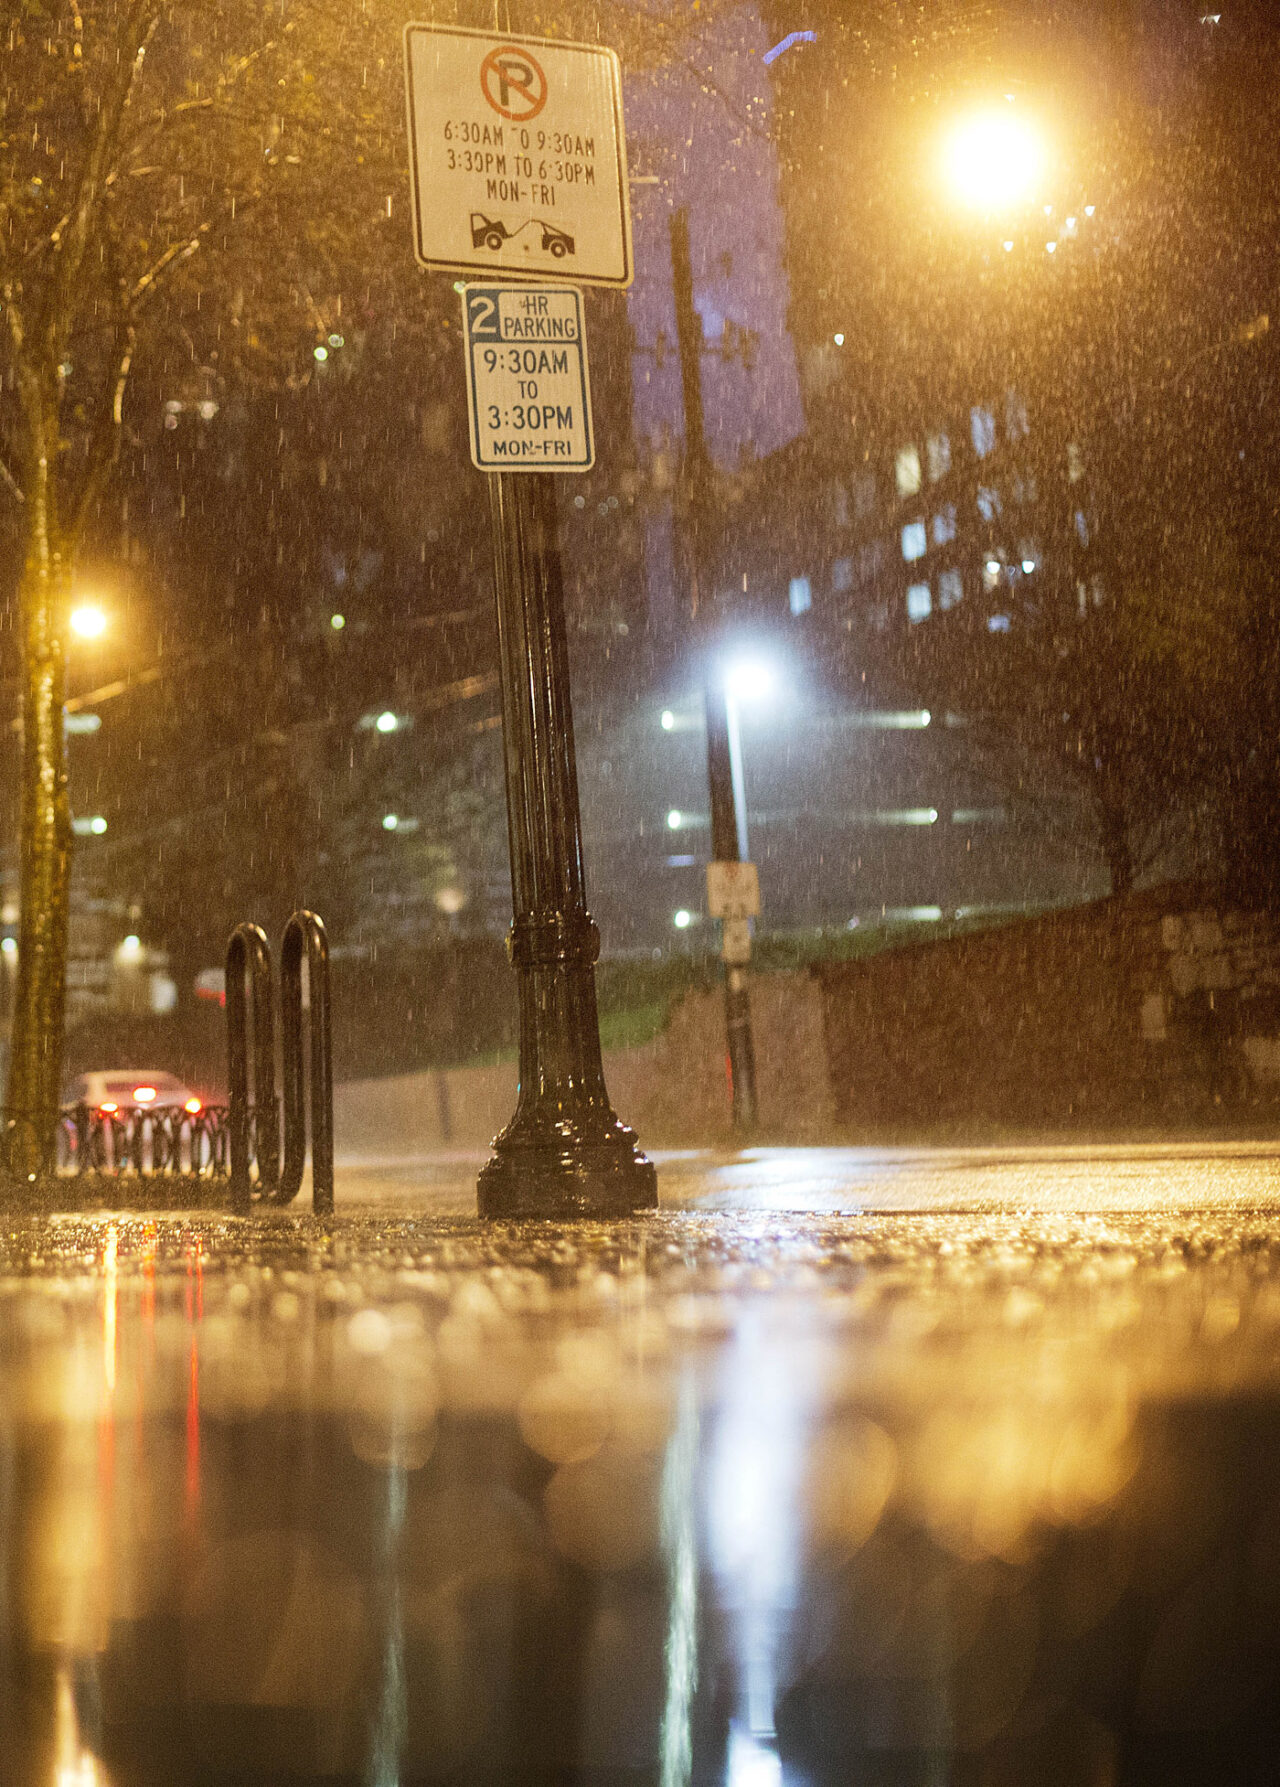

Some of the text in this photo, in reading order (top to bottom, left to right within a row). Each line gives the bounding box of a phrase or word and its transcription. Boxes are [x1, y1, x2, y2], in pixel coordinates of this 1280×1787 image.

[498, 59, 534, 106] P
[444, 120, 595, 157] 6:30AM O 9:30AM
[447, 149, 506, 175] 3:30PM
[514, 155, 532, 178] TO
[487, 179, 556, 206] MON-FRI
[470, 295, 548, 333] 2 HR
[504, 317, 575, 338] PARKING
[483, 349, 568, 374] 9:30AM
[518, 380, 538, 399] TO
[488, 405, 573, 429] 3:30PM
[493, 440, 571, 456] MON-FRI
